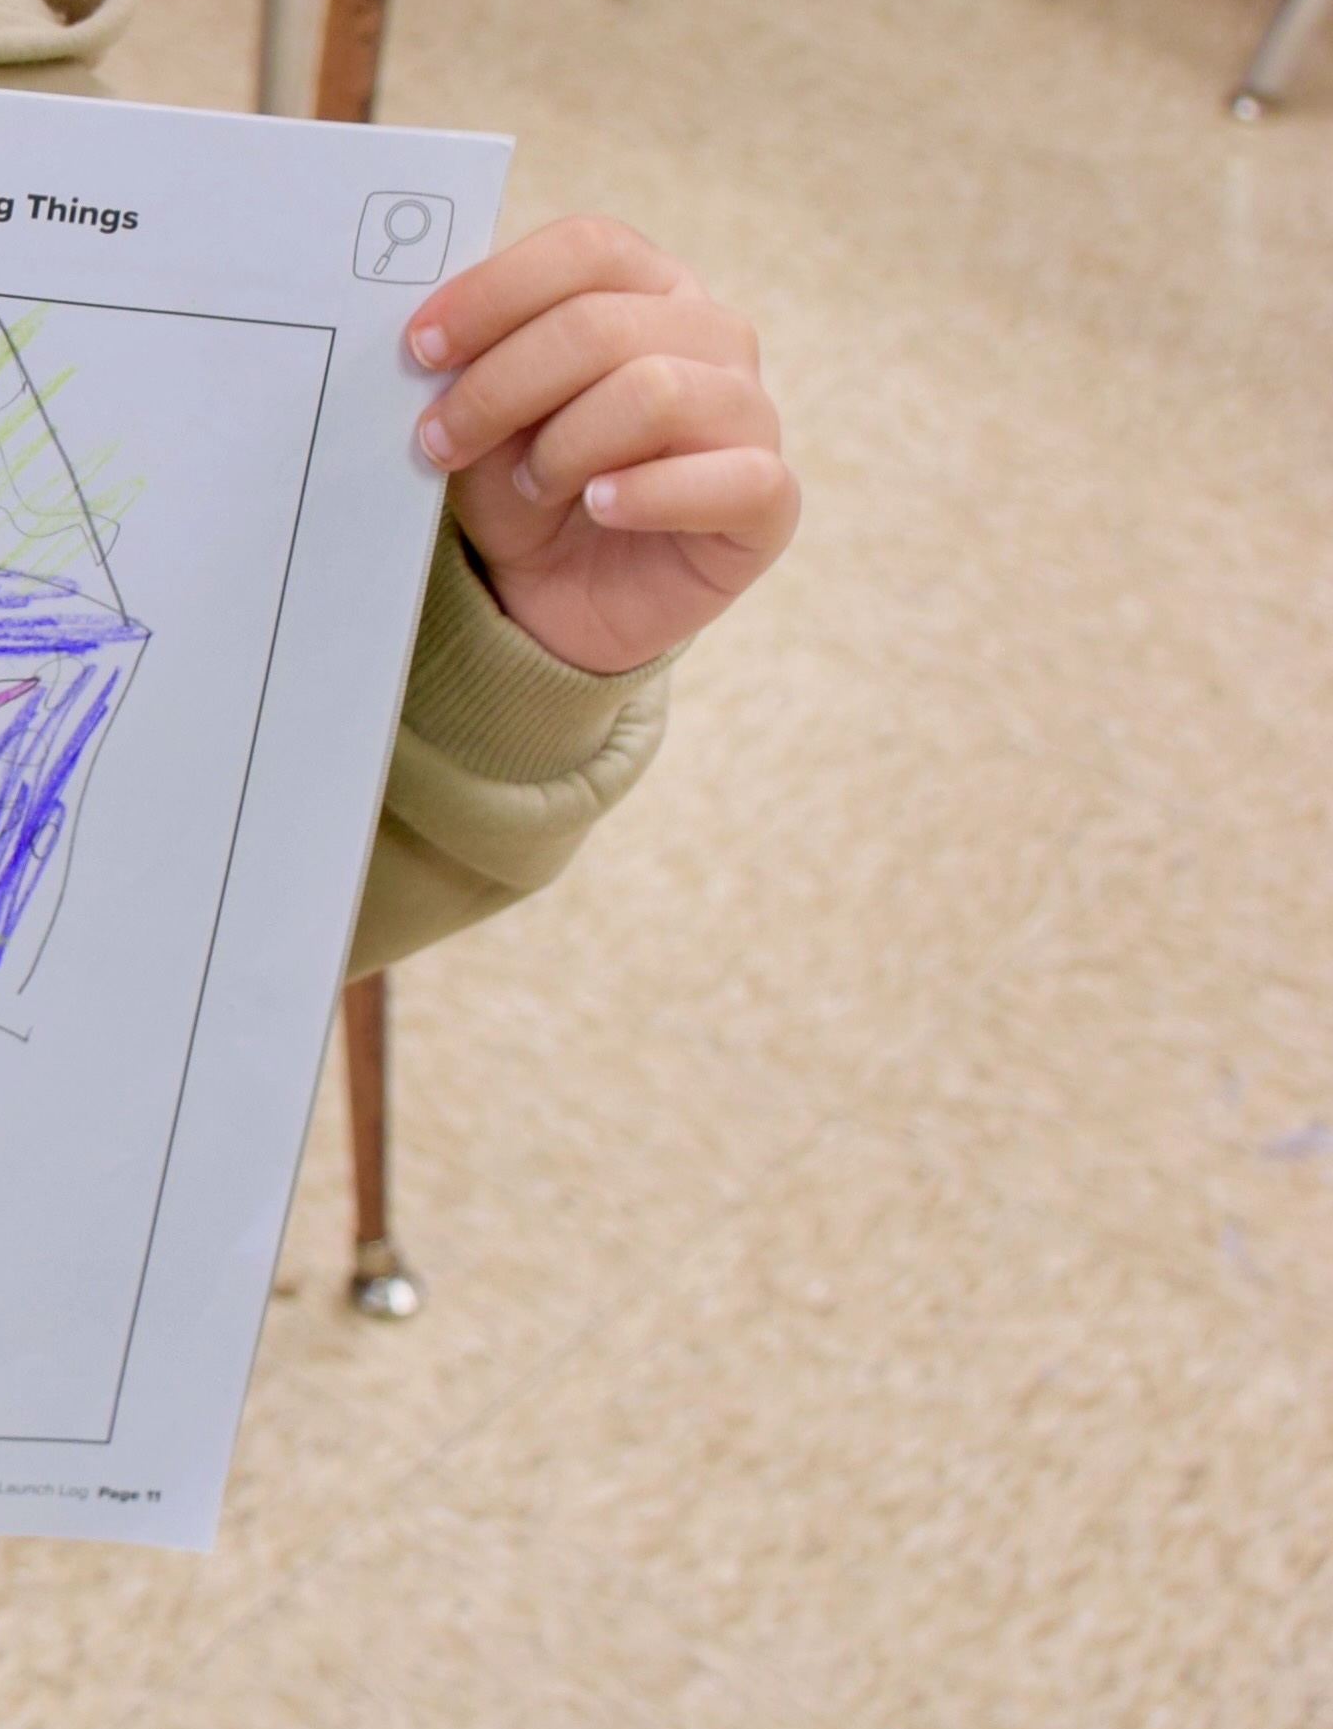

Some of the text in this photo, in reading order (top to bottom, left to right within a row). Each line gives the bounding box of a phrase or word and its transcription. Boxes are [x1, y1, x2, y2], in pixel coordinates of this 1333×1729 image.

[27, 193, 140, 235] Things
[59, 1484, 90, 1502] Log
[98, 1486, 140, 1504] Page
[147, 1489, 162, 1503] 11
